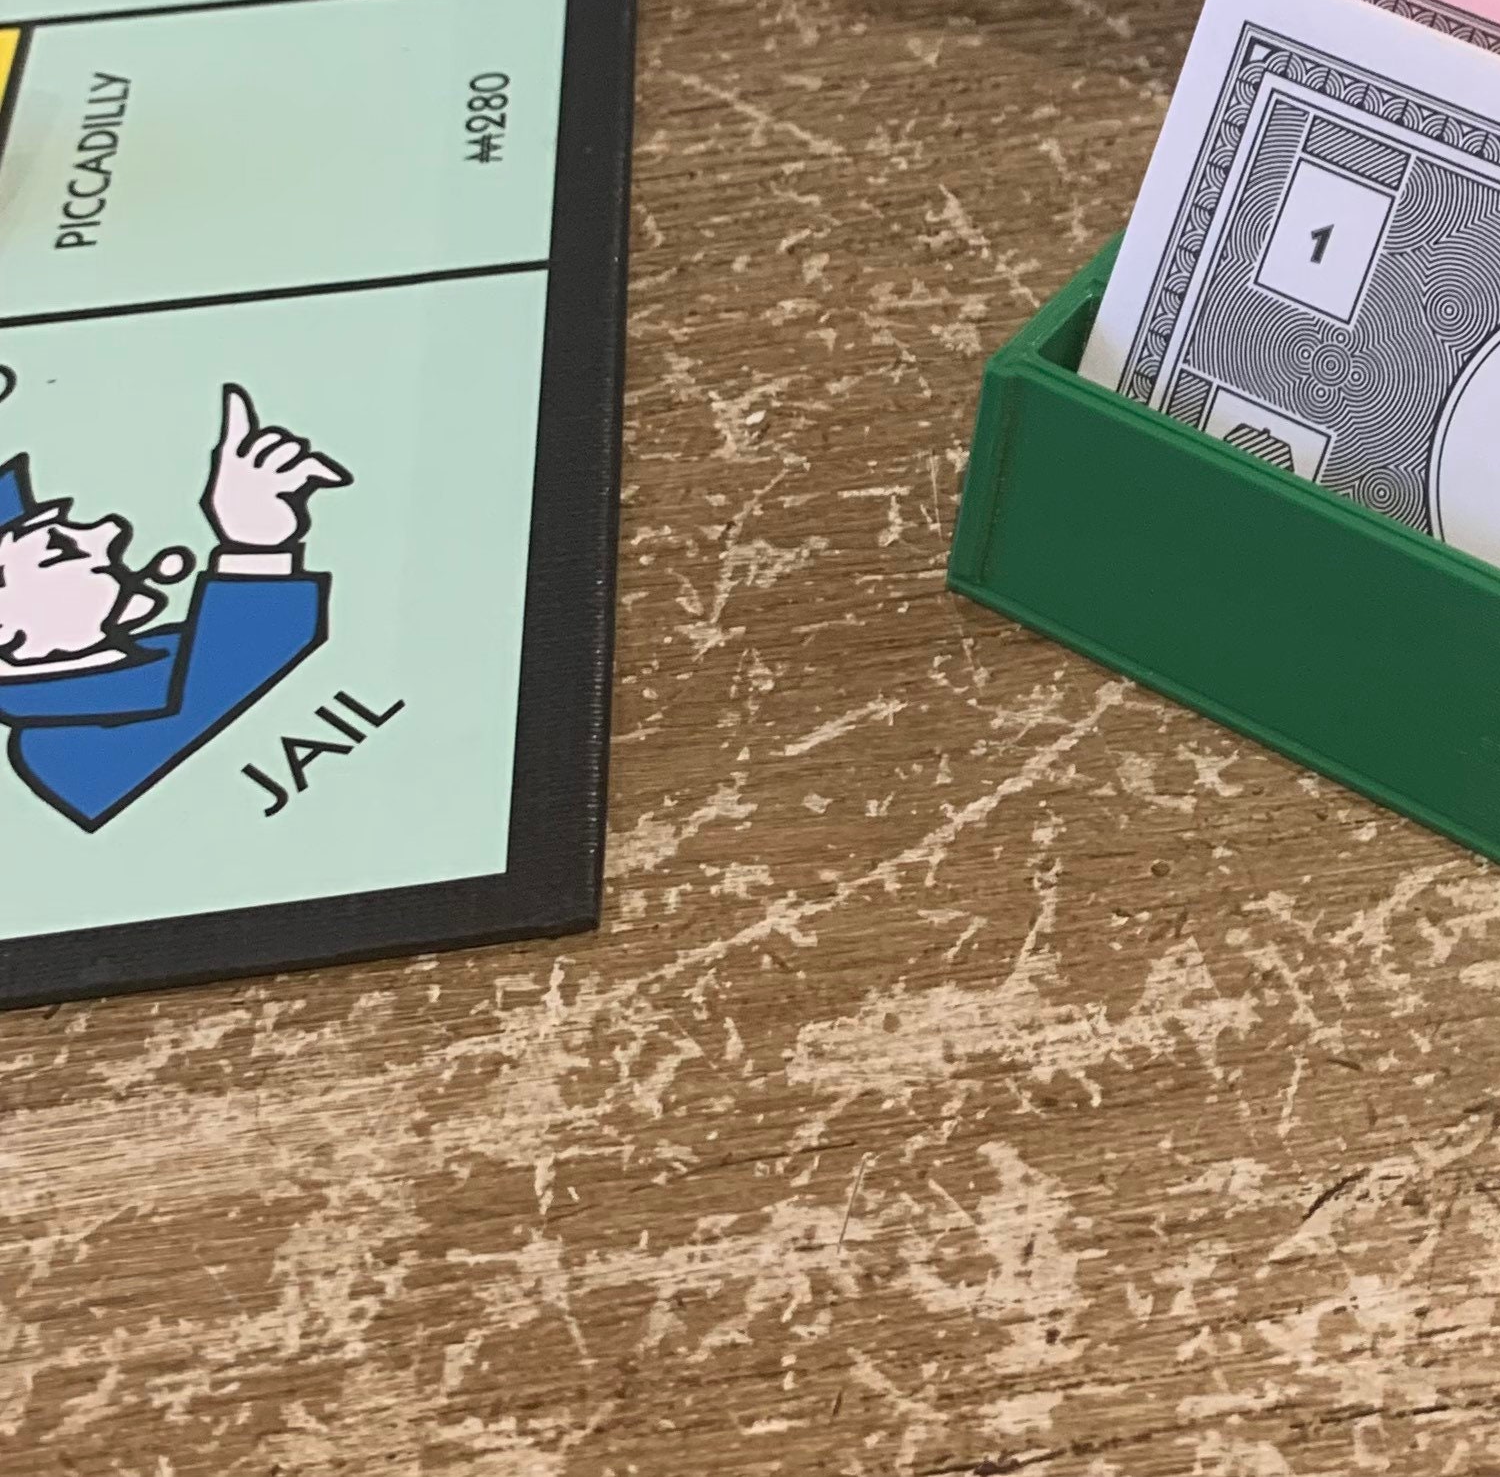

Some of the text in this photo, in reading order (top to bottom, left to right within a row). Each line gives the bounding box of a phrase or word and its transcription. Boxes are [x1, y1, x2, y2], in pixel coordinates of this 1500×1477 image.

[55, 72, 131, 250] PICCADILLY
[1311, 225, 1335, 265] 1
[241, 690, 405, 817] JAIL
